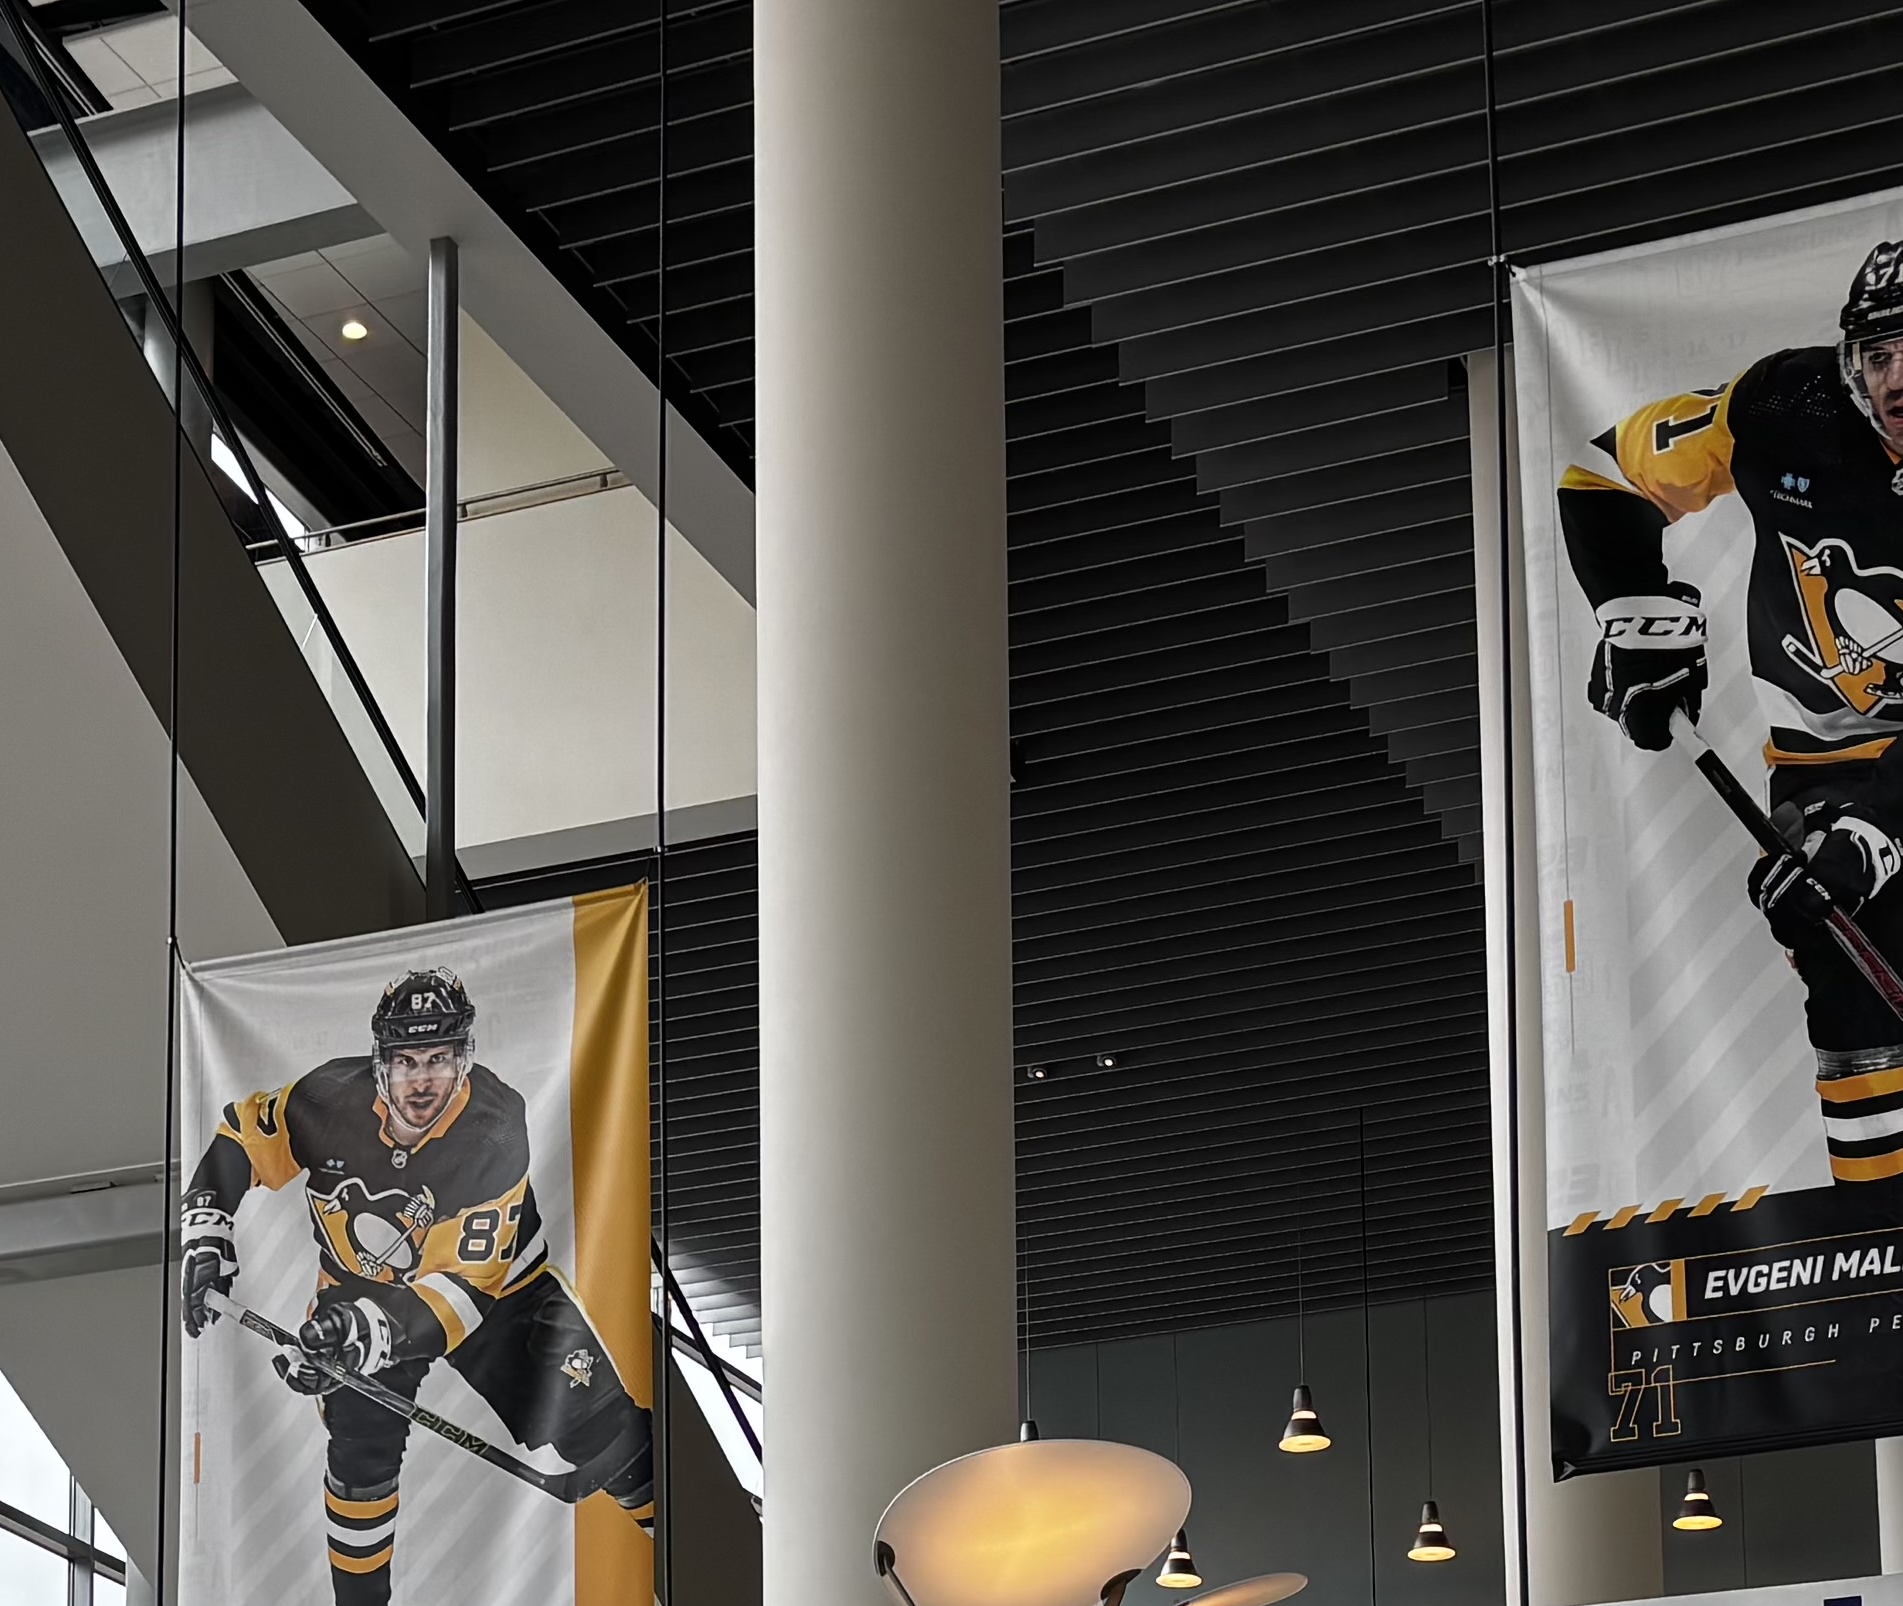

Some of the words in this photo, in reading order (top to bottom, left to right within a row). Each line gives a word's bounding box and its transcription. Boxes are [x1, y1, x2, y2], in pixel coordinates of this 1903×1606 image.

[1604, 616, 1708, 639] CCM
[410, 992, 436, 1011] 87
[408, 1022, 439, 1035] CCM
[1705, 1254, 1823, 1301] EVGENI
[1630, 1321, 1843, 1366] PITTSBURGH
[1608, 1366, 1681, 1442] 71
